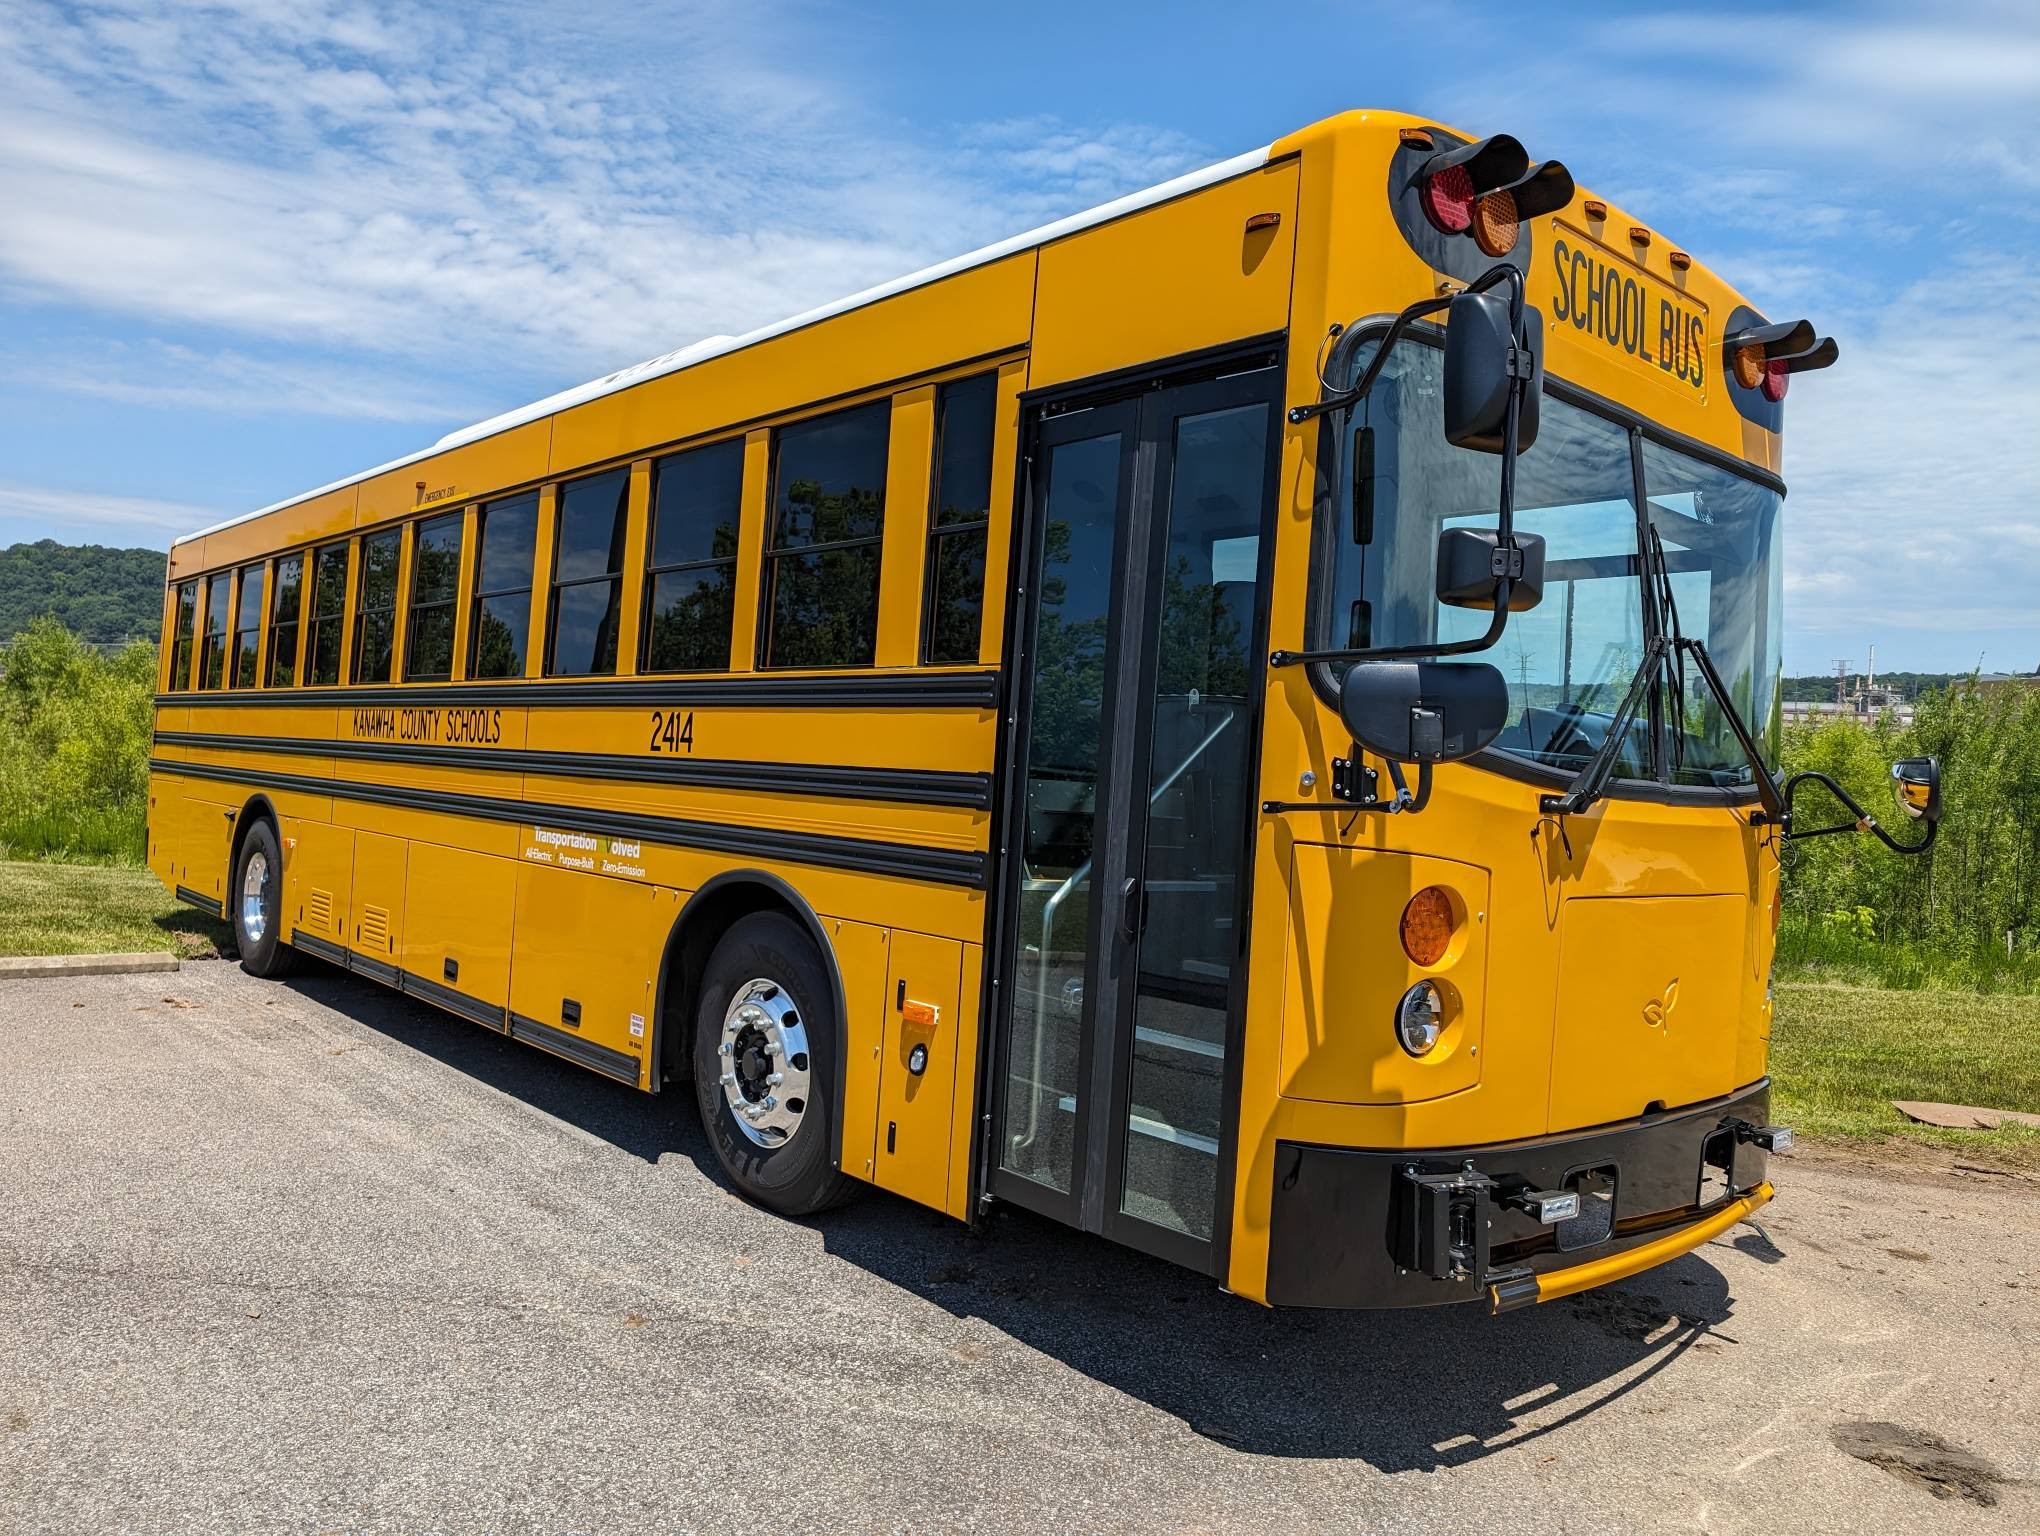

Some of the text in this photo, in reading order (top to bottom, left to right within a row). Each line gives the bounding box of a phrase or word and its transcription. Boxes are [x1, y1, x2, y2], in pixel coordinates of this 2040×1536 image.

[1553, 239, 1704, 389] SCHOOL BUS
[353, 708, 501, 744] KANAWHA COUNTY SCHOOLS
[650, 711, 694, 754] 2414
[534, 826, 597, 850] Transportation
[559, 853, 594, 869] Purpose-Built
[602, 860, 646, 877] Zero-Emission
